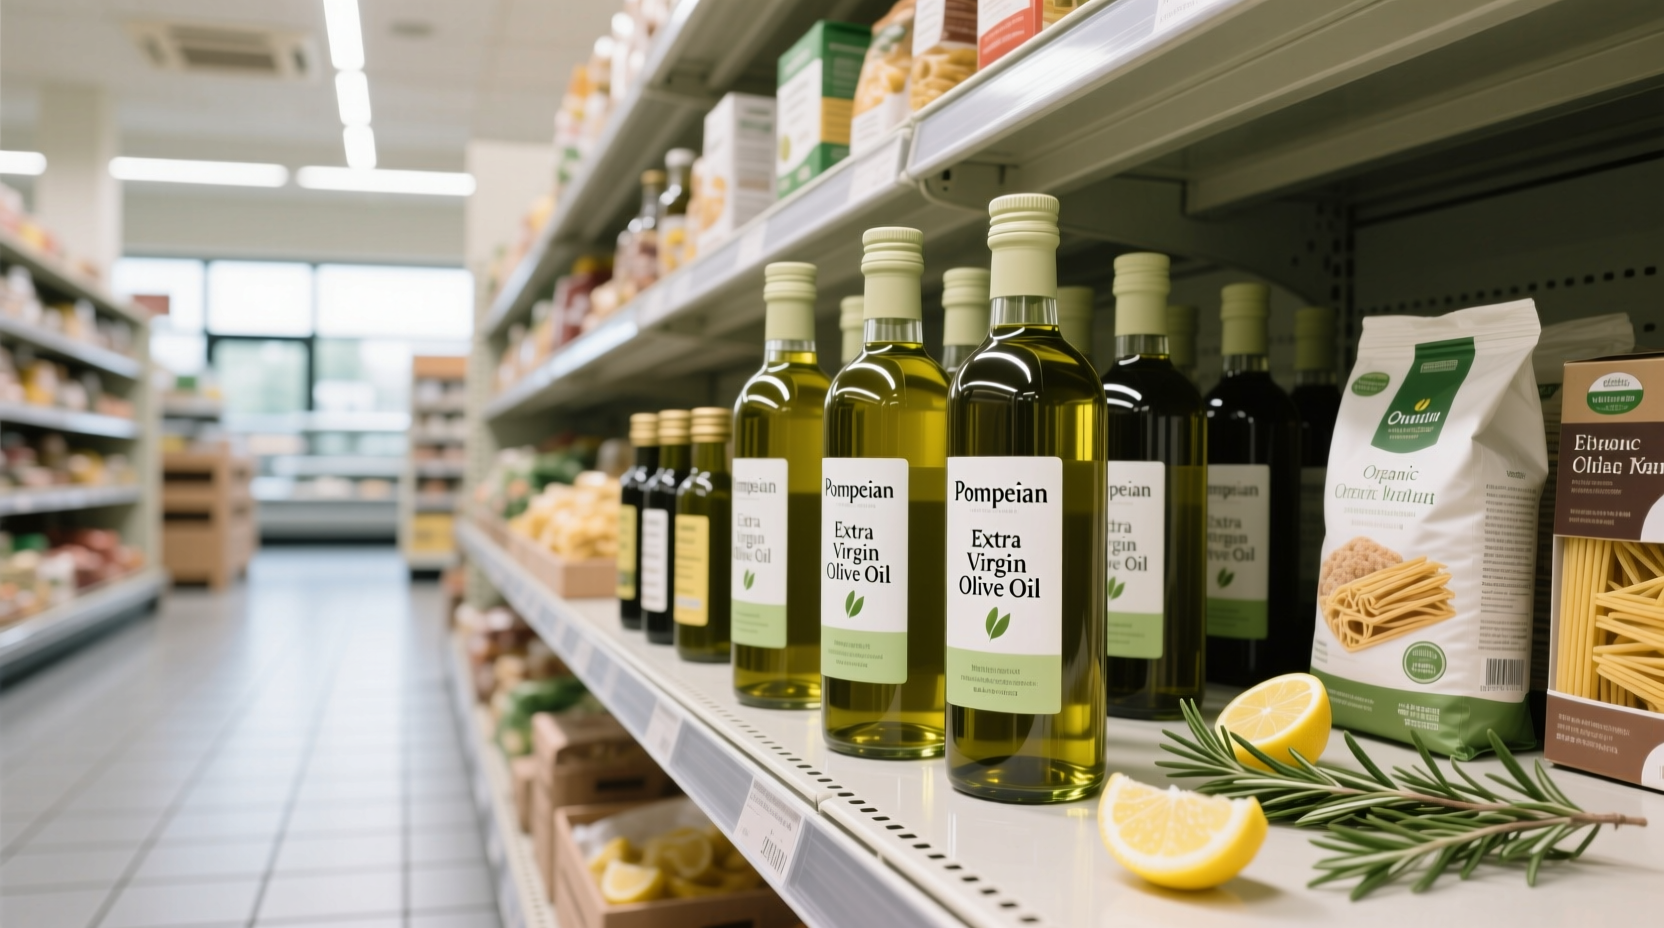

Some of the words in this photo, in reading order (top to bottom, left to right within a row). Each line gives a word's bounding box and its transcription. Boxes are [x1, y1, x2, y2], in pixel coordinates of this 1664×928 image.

[825, 477, 894, 504] Pompeian
[954, 480, 1048, 509] Pompeian
[1109, 480, 1152, 501] peian
[835, 520, 874, 540] Extra
[971, 529, 1022, 549] Extra
[755, 548, 771, 564] Oil
[833, 542, 879, 565] Virgin
[1125, 555, 1148, 571] Oil
[1232, 547, 1255, 562] Oil
[826, 562, 861, 582] Olive
[865, 565, 891, 584] Oil
[966, 551, 1027, 578] Virgin
[959, 575, 1005, 597] Olive
[1009, 578, 1041, 598] Oil
